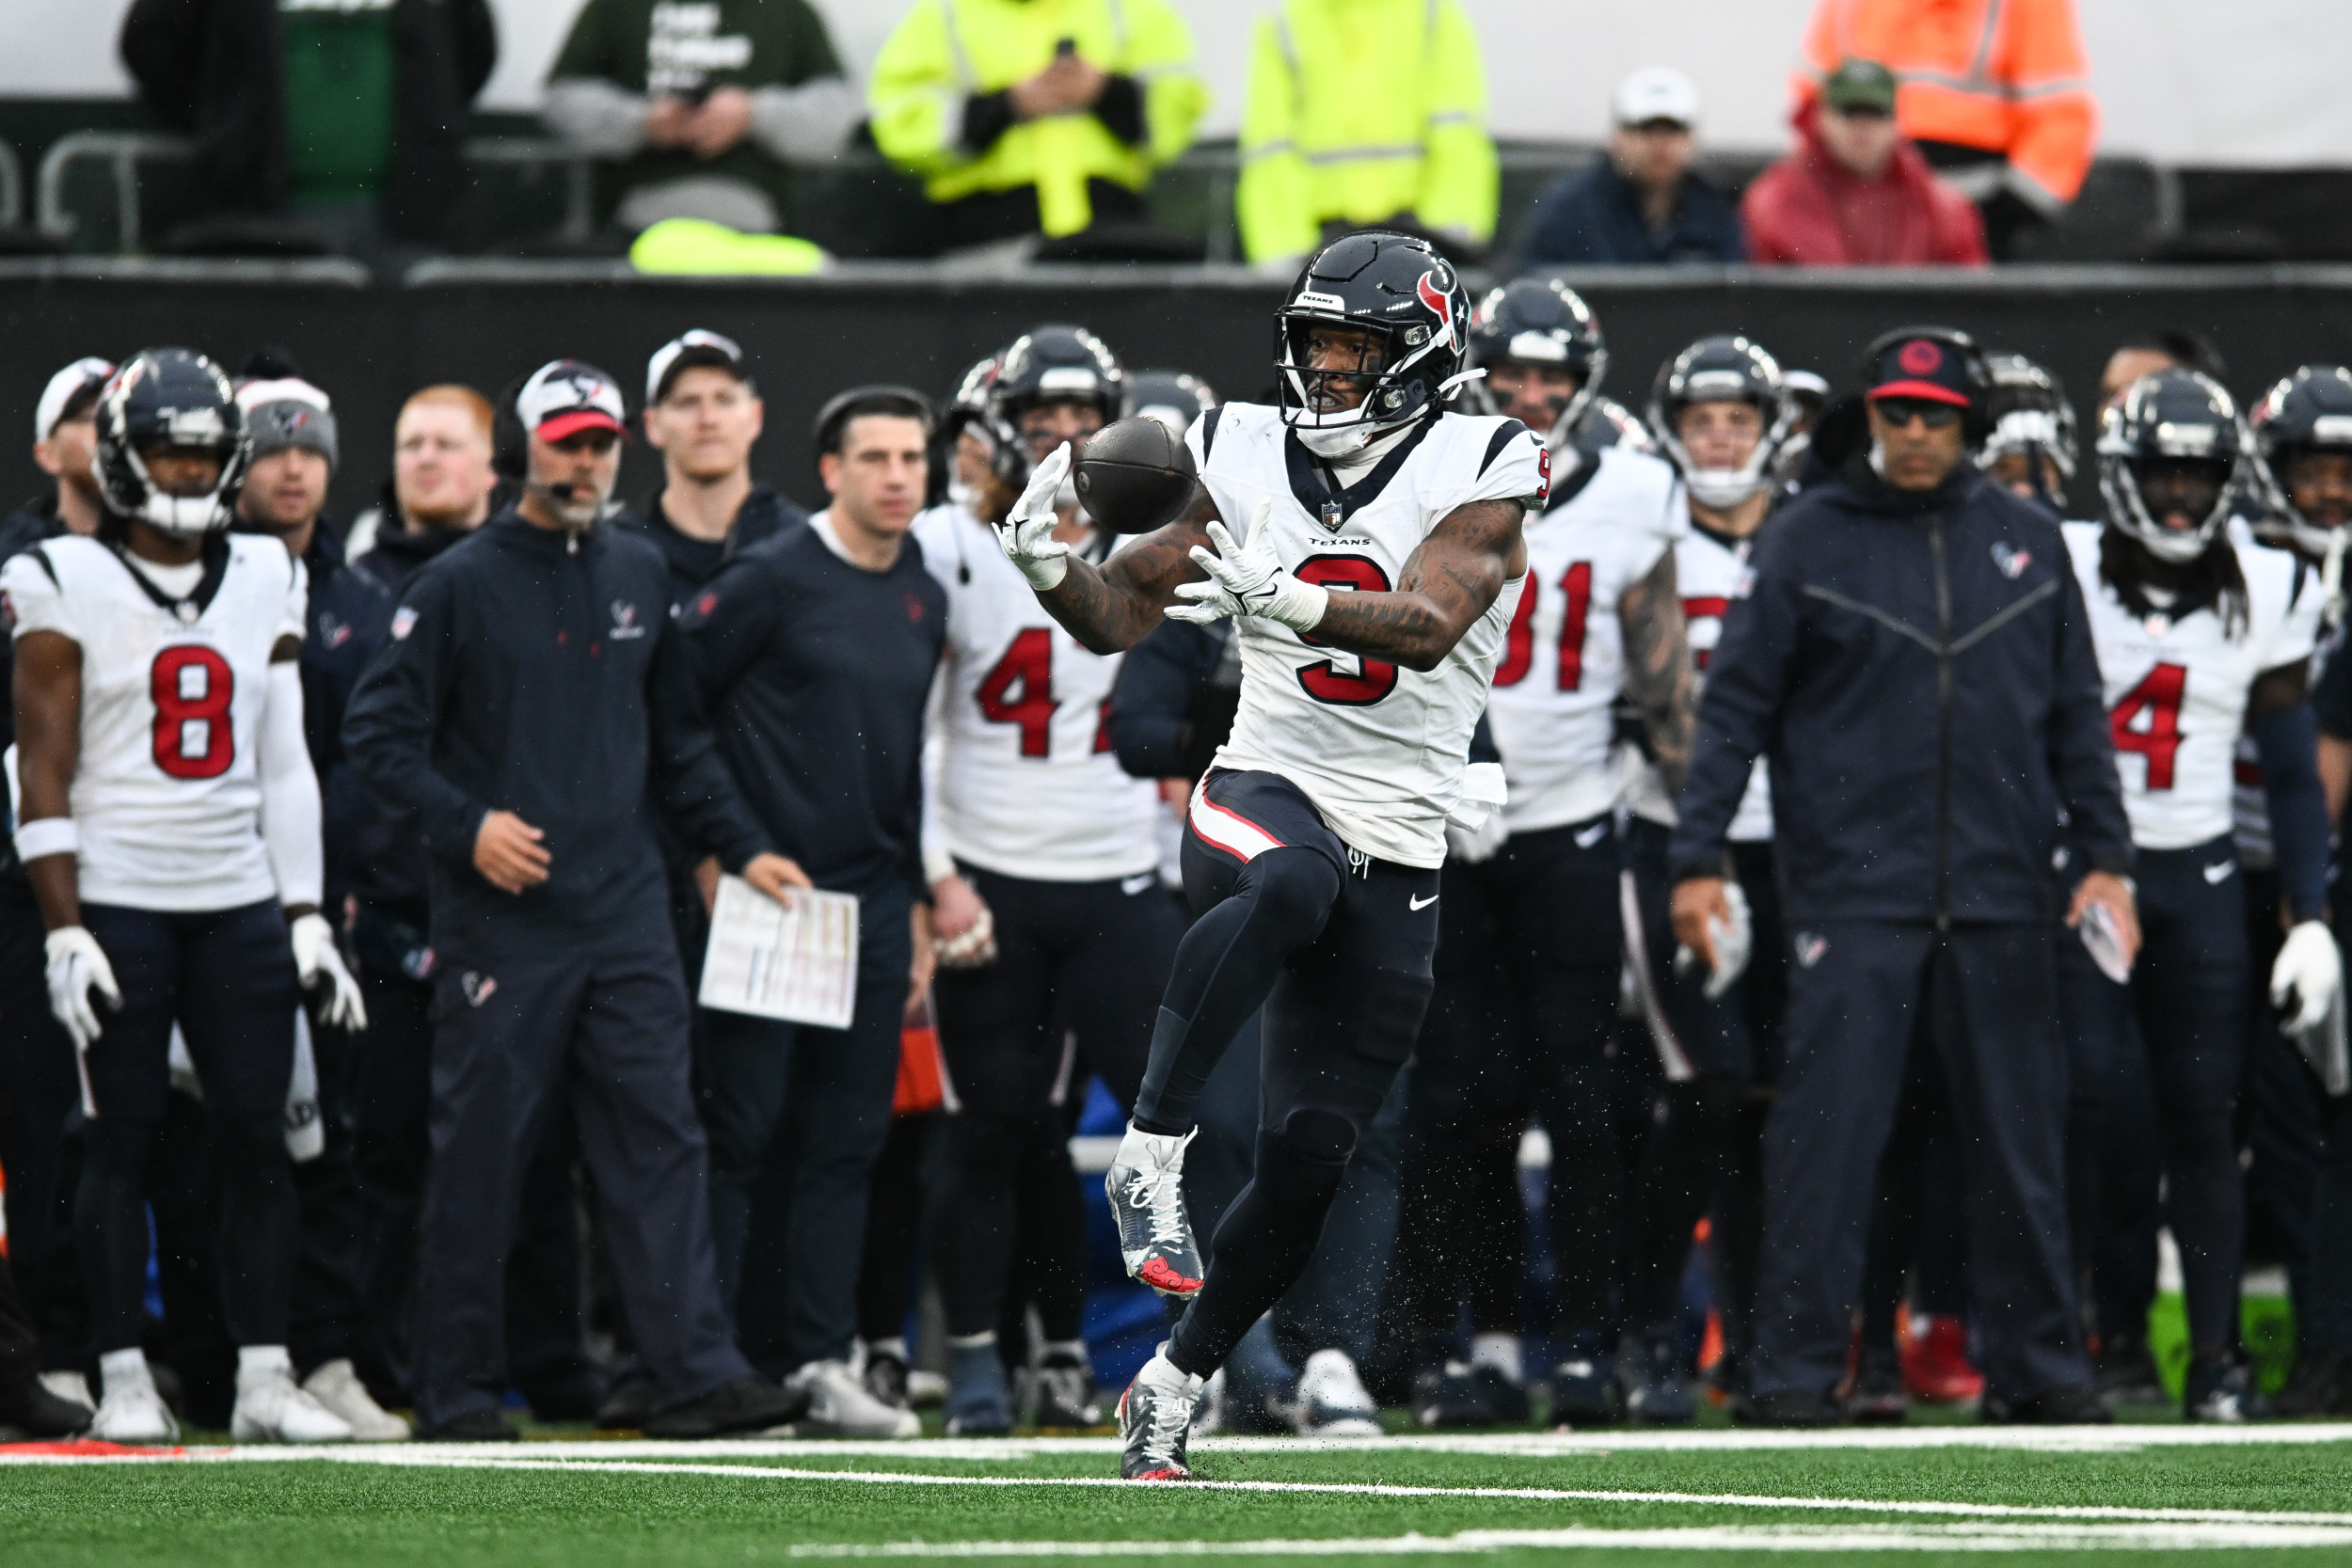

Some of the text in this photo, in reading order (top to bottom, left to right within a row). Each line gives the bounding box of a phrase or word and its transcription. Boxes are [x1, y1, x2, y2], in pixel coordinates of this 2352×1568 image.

[1303, 295, 1334, 305] TEXANS
[1536, 448, 1551, 500] 9
[1309, 537, 1371, 546] TEXANS
[151, 643, 235, 781] 8
[973, 626, 1113, 758] 4
[2109, 661, 2188, 792] 4
